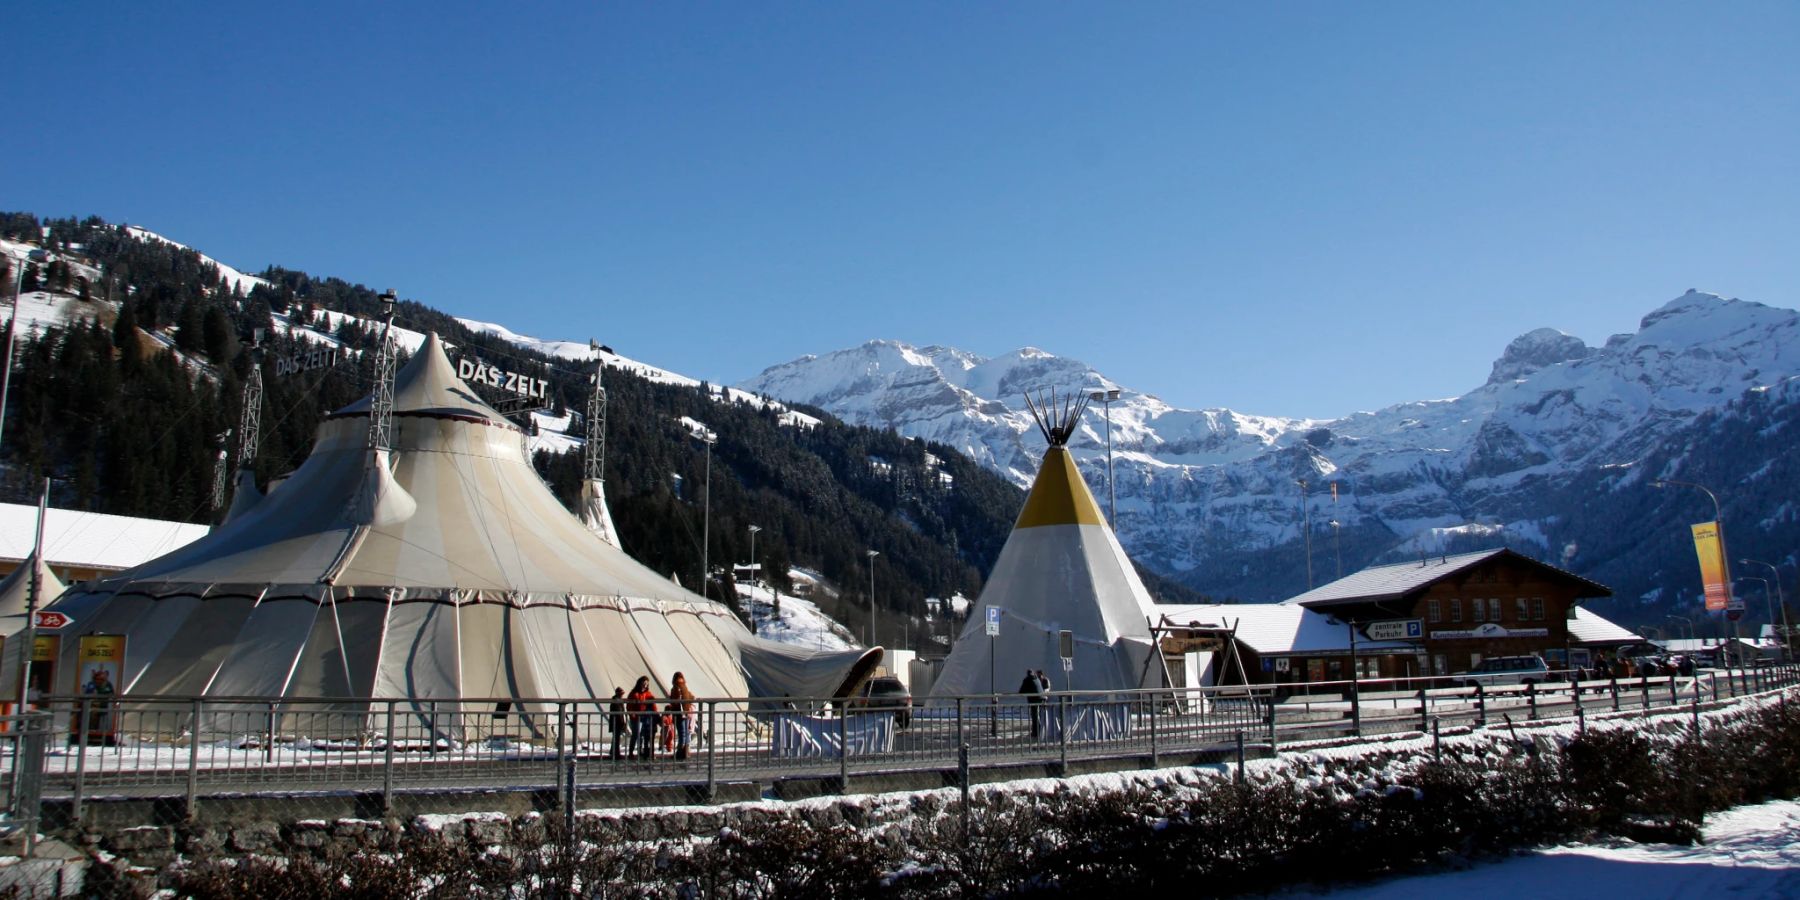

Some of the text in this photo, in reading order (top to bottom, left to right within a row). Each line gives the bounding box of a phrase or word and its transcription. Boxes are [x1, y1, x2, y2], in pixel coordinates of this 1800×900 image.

[276, 355, 300, 377] DAS
[459, 359, 548, 399] DAS ZELT
[1375, 622, 1402, 630] zentrale
[1410, 623, 1417, 635] P
[1375, 630, 1402, 638] Parkuhr
